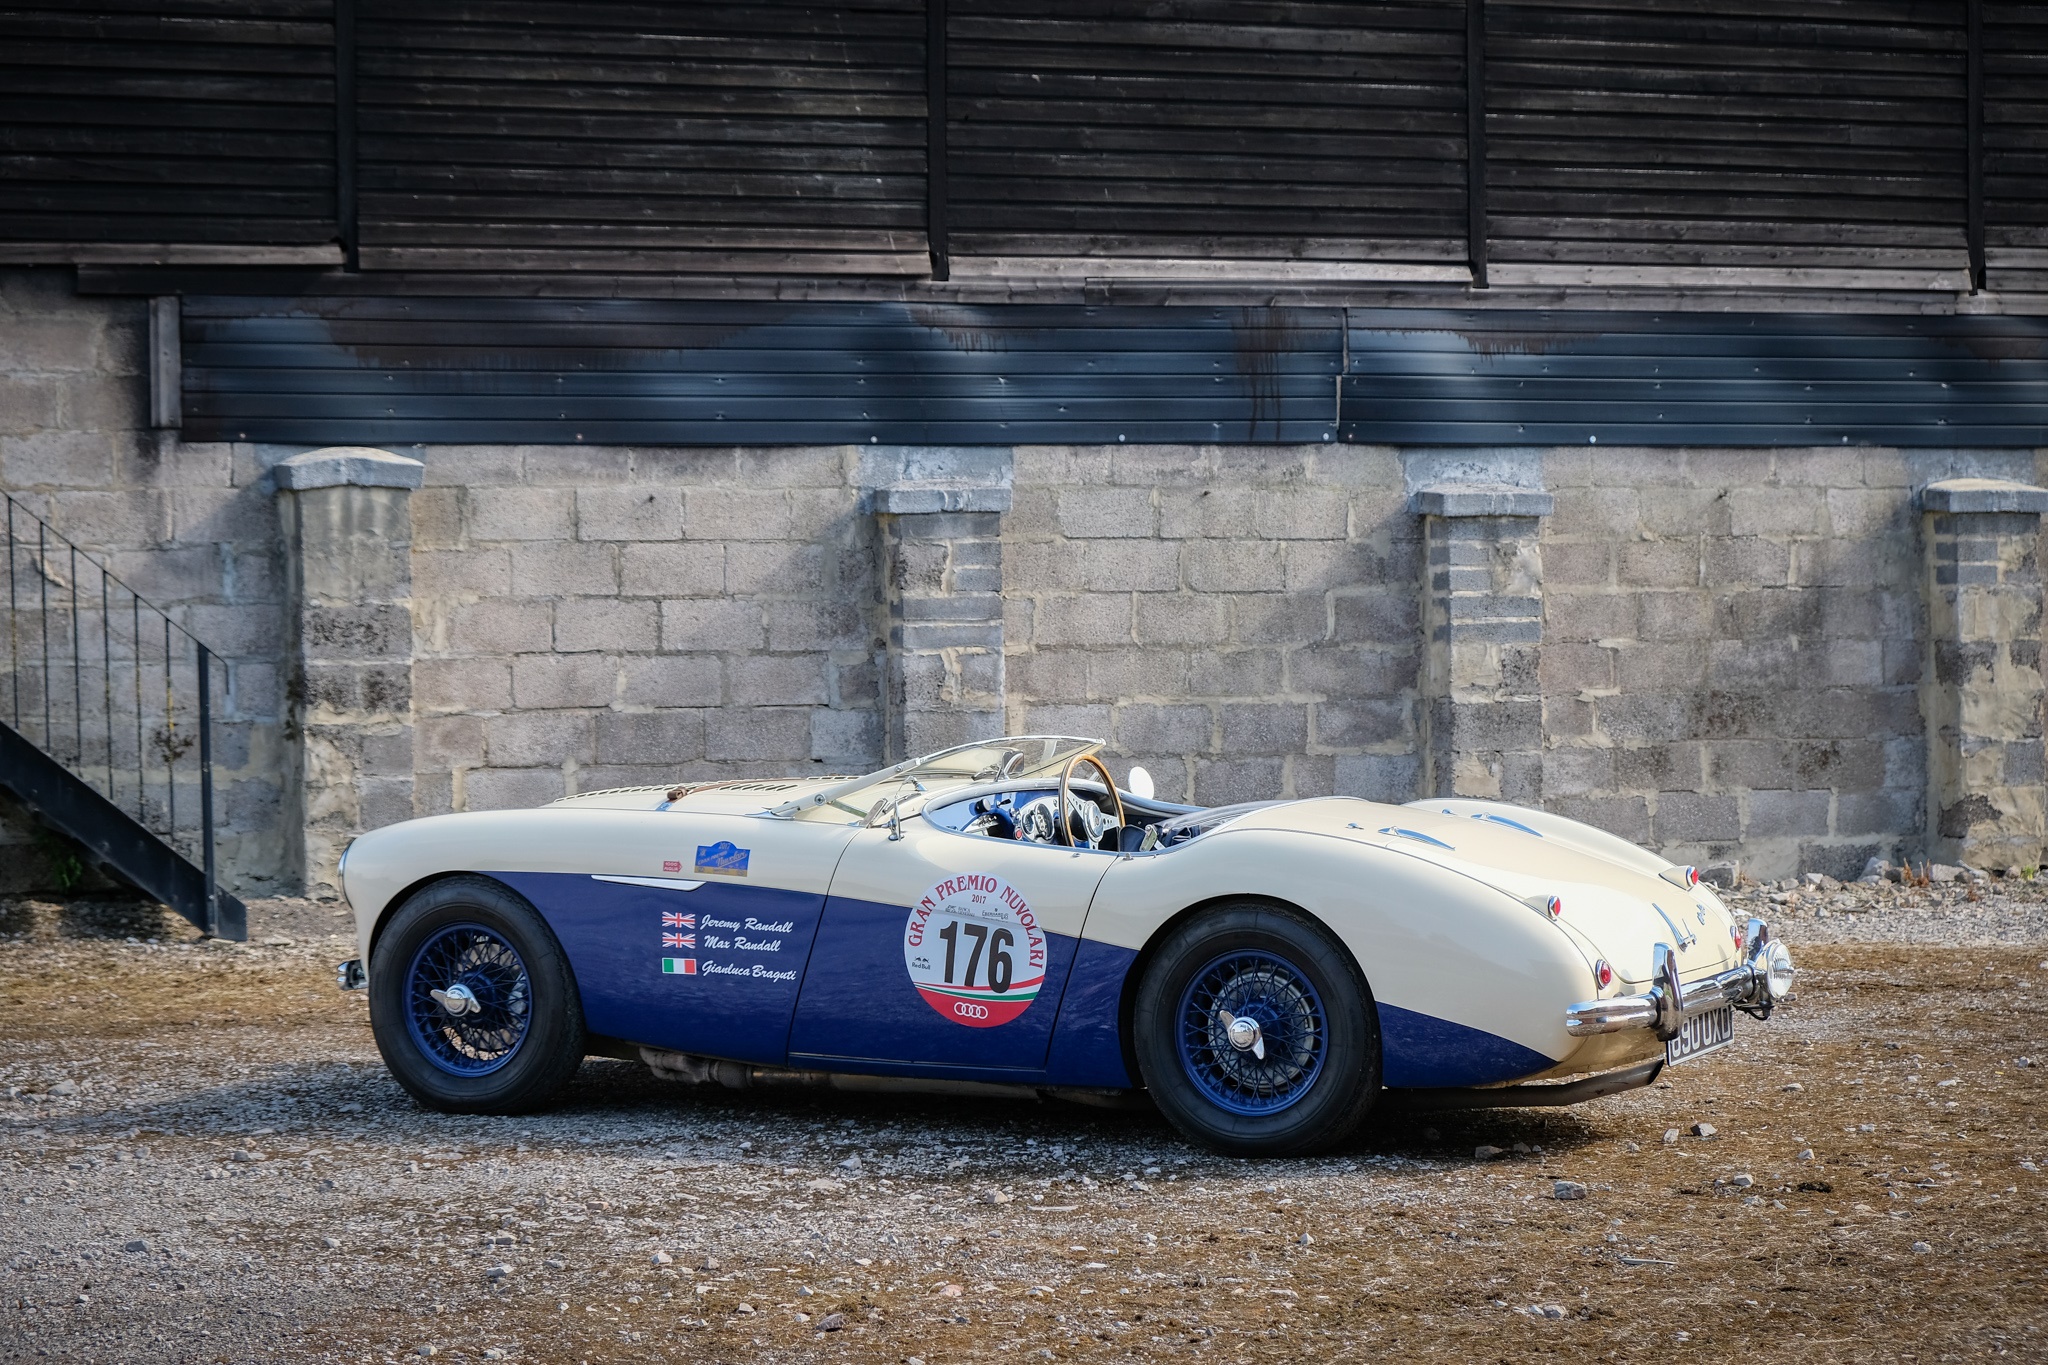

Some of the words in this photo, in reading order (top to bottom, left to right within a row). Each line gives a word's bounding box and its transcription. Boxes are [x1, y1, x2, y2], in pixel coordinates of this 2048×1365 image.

[972, 894, 986, 904] 2017
[700, 914, 740, 932] Jeremy
[744, 918, 793, 933] Randall
[908, 896, 936, 946] GRAN
[935, 875, 997, 900] PREMIO
[1000, 886, 1043, 969] NUVOLARI
[704, 935, 730, 949] Max
[734, 936, 781, 952] Randall
[939, 921, 1014, 993] 176
[702, 960, 750, 976] Gianluca
[752, 965, 797, 982] Braguti
